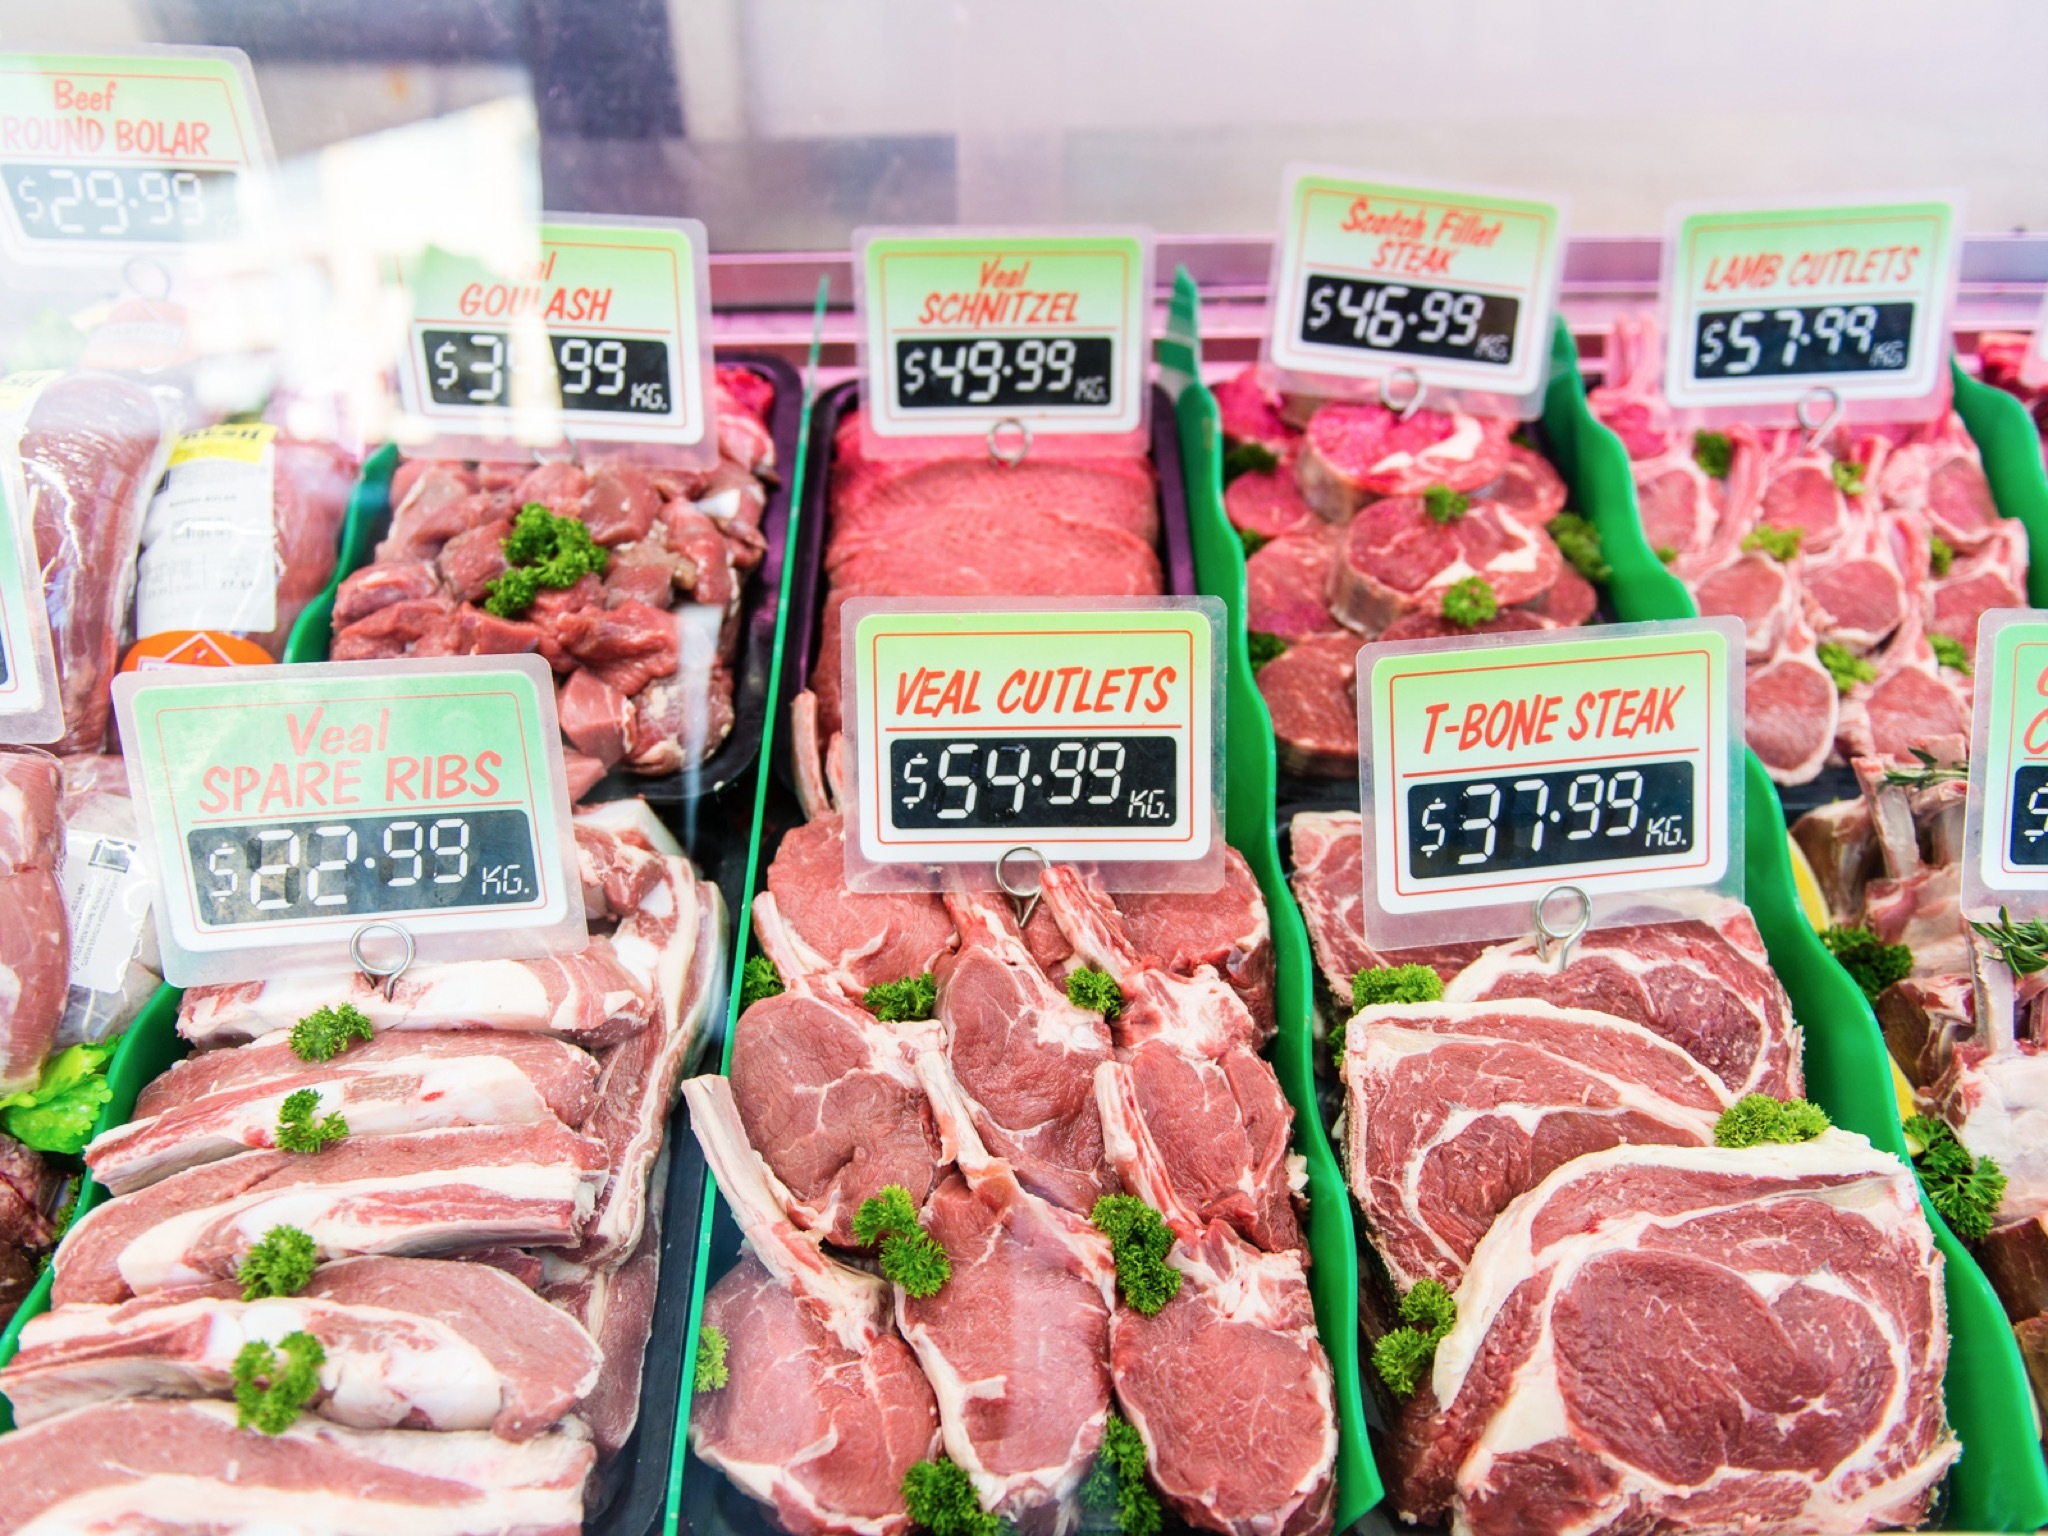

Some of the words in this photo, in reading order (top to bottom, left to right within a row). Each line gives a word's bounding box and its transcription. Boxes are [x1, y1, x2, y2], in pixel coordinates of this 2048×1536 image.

[54, 79, 117, 111] Beef
[2, 115, 105, 151] ROUND
[115, 119, 209, 156] BOLAR
[18, 169, 205, 234] $29.99
[979, 256, 1031, 288] Veal
[1371, 241, 1460, 274] STEAK
[1704, 253, 1783, 292] LAMB
[1789, 245, 1921, 287] CUTLETS
[919, 292, 1079, 329] SCHNITZEL
[1308, 285, 1484, 347] $46.99
[1699, 306, 1877, 374] $57.99
[630, 383, 668, 410] KG.
[904, 340, 1076, 402] $49.99
[895, 666, 982, 718] VEAL
[995, 665, 1177, 714] CUTLETS
[1423, 694, 1563, 754] T-BONE
[1568, 684, 1686, 741] STEAK
[285, 705, 390, 756] Veal
[198, 759, 362, 814] SPARE
[384, 749, 502, 802] RIBS
[902, 741, 1126, 819] $54.99
[1127, 789, 1170, 819] KG.
[1420, 770, 1643, 865] $37.99
[1645, 814, 1688, 848] KG.
[208, 818, 469, 911] $22.99
[481, 864, 530, 896] KG.
